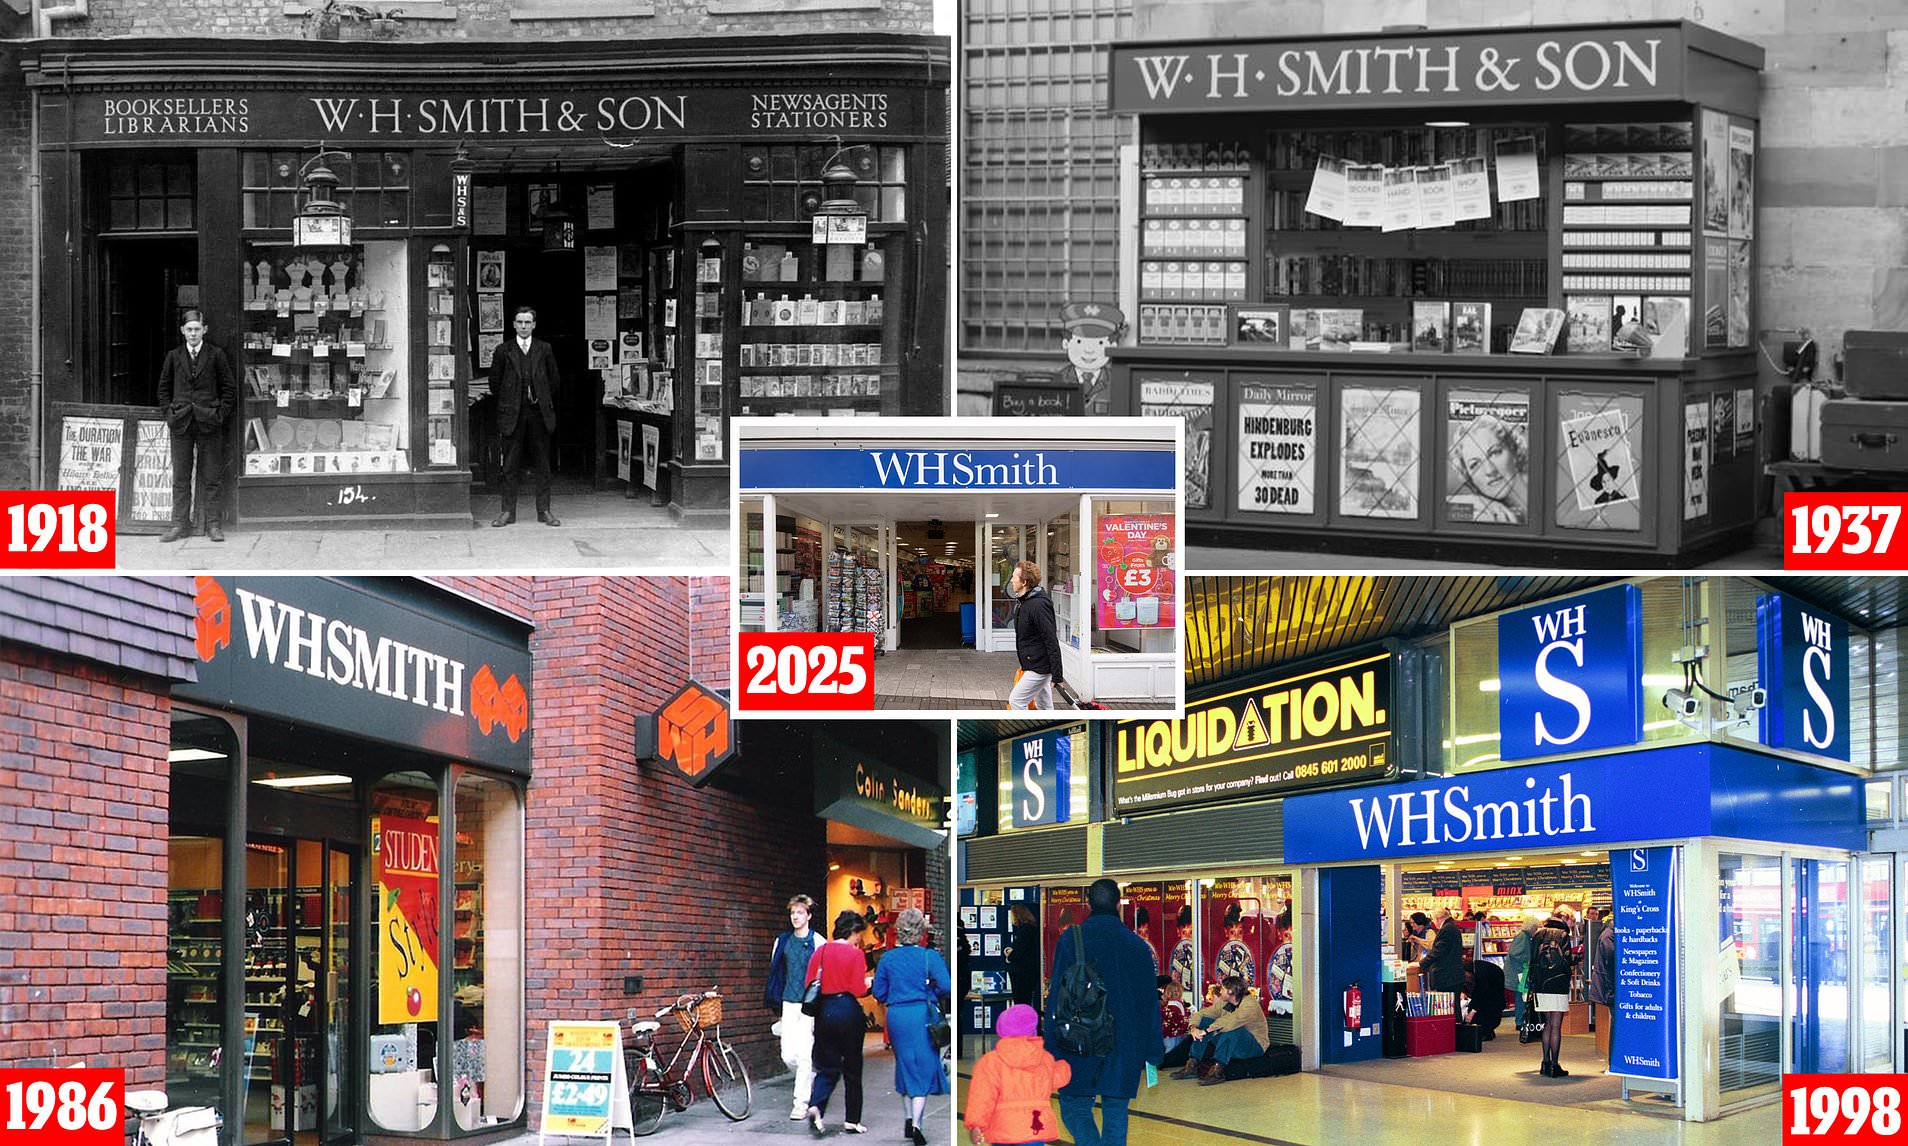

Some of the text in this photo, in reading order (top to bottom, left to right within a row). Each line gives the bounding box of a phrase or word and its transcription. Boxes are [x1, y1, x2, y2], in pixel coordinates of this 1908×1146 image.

[1475, 48, 1520, 91] &
[1534, 40, 1662, 91] SON
[104, 98, 249, 116] BOOKSELLERS
[751, 94, 888, 111] NEWSAGENTS
[597, 95, 688, 131] SON
[751, 111, 888, 128] STATIONERS
[104, 116, 249, 134] LIBRARIANS
[1002, 394, 1025, 415] Buy
[1244, 387, 1314, 404] Daily Mirror
[79, 426, 121, 443] DURATION
[1244, 416, 1312, 436] HINDENBURG
[72, 445, 112, 463] THE WAR
[1250, 441, 1305, 461] EXPLODES
[872, 451, 1060, 486] WHSmith
[1261, 470, 1293, 479] MORE THAN
[1255, 486, 1299, 505] 30 DEAD
[1105, 523, 1168, 531] VALENTINE'S
[1127, 531, 1147, 539] DAY
[1124, 569, 1152, 586] £3
[1532, 605, 1587, 643] WH
[1800, 612, 1832, 651] WH
[236, 588, 465, 717] WHSMITH
[1534, 637, 1592, 746] S
[1803, 646, 1836, 749] S
[1023, 738, 1044, 760] WH
[1167, 789, 1177, 799] Bug
[1178, 788, 1186, 796] got
[1187, 786, 1192, 795] in
[1192, 784, 1205, 795] store
[1205, 782, 1213, 793] for
[1213, 781, 1226, 792] your
[1226, 776, 1254, 790] company?
[1255, 774, 1270, 785] Find
[1282, 769, 1295, 781] Call
[1295, 762, 1319, 779] 0845
[1321, 759, 1339, 775] 601
[1341, 754, 1367, 772] 2000
[1023, 757, 1045, 821] S
[1349, 772, 1597, 851] WHSmith
[1623, 889, 1656, 897] WHSmith
[1620, 905, 1659, 914] King's Cross
[1623, 948, 1657, 957] Newspapers
[1628, 957, 1659, 966] Magazines
[1620, 969, 1661, 979] Confectionery
[1641, 979, 1661, 987] Drinks
[1628, 990, 1652, 998] Tobacco
[1632, 1012, 1656, 1020] children
[1644, 1003, 1663, 1011] adults
[568, 1050, 595, 1073] 24
[1624, 1055, 1660, 1067] WHSmith
